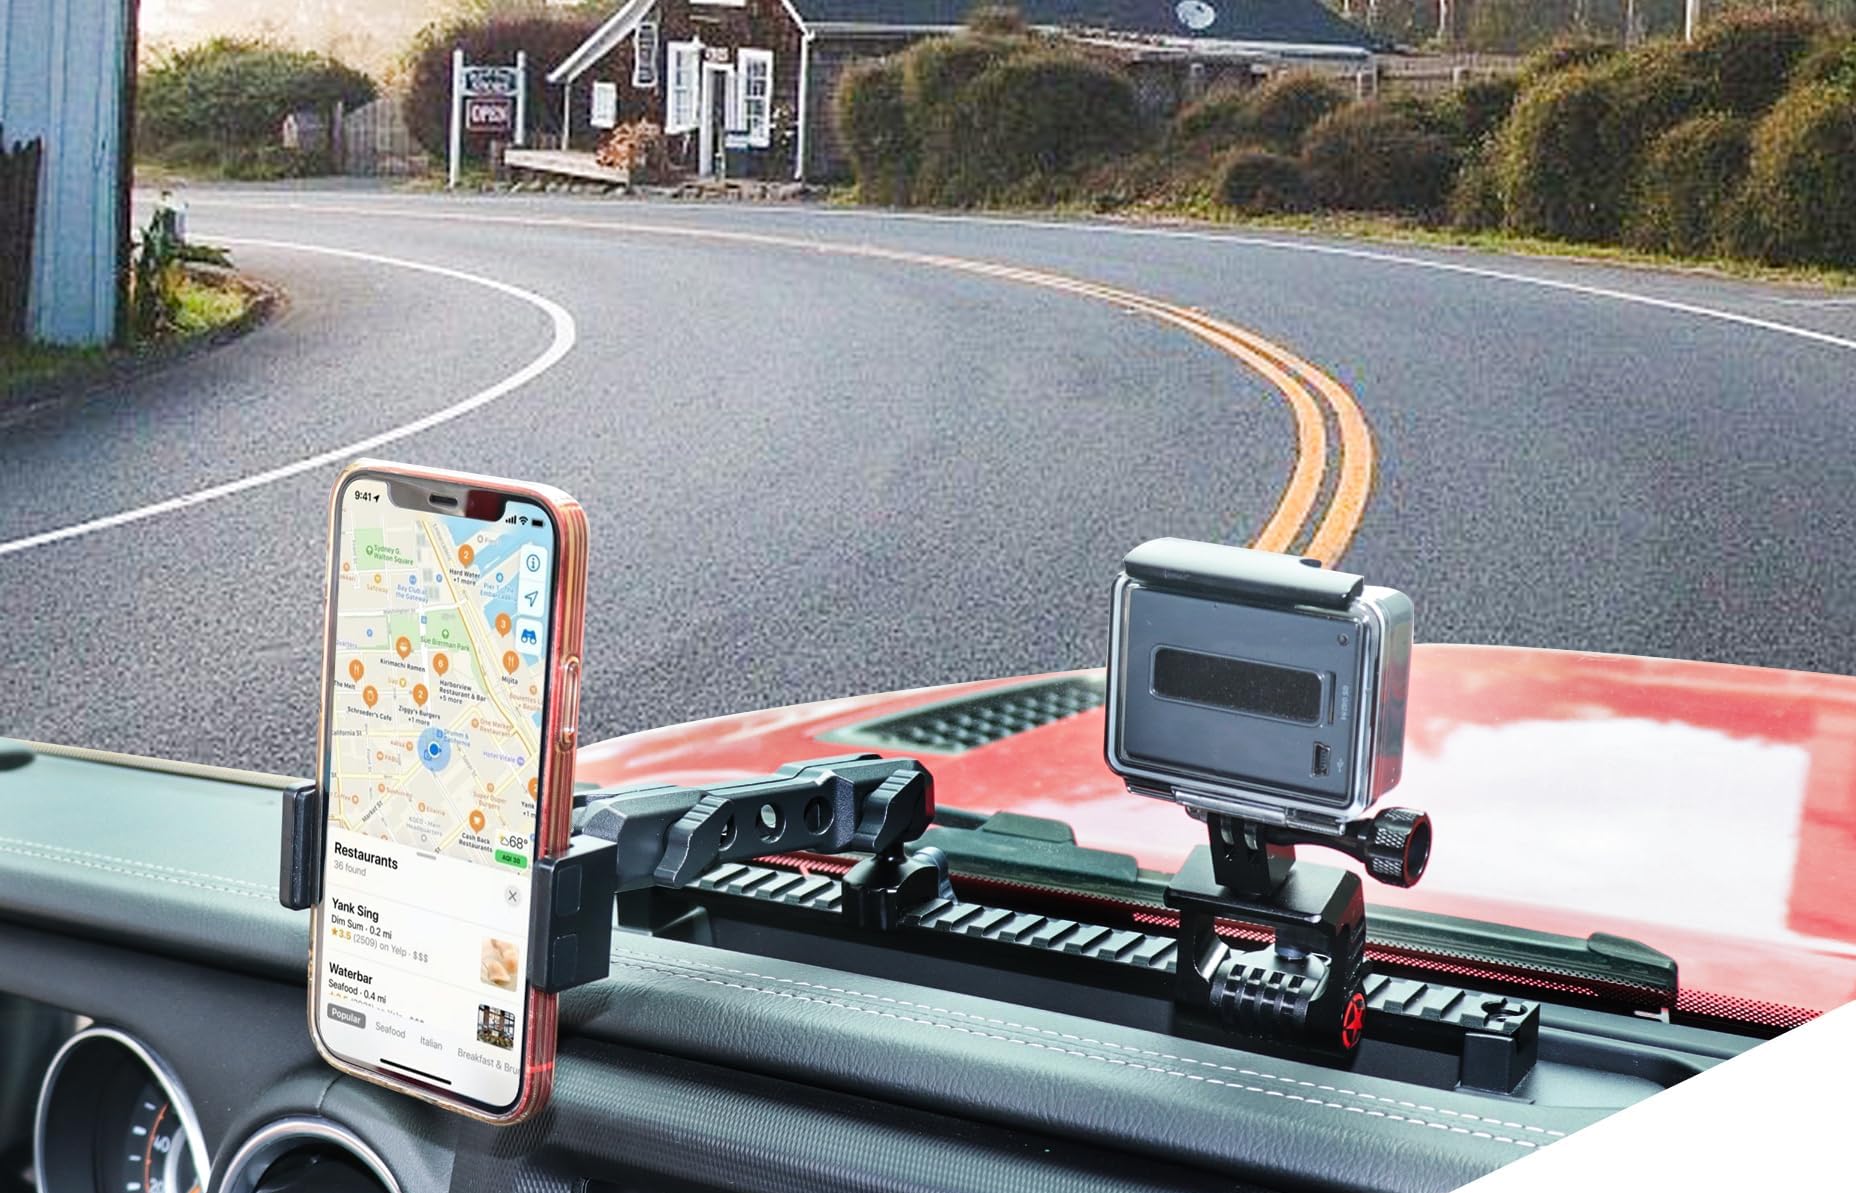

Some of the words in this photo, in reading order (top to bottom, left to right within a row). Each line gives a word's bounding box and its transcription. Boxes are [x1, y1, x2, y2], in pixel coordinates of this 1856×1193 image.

[354, 490, 372, 502] 9:41
[449, 568, 463, 576] Hard
[464, 571, 480, 579] Water
[407, 663, 426, 672] Ramen
[440, 687, 470, 699] Restaurant
[476, 694, 487, 702] Bar
[419, 710, 440, 720] Burgers
[459, 838, 493, 853] Restaurants
[461, 832, 476, 841] Cash
[477, 836, 490, 845] Back
[334, 841, 399, 870] Restaurants
[333, 859, 344, 870] 36
[345, 863, 367, 877] found
[332, 897, 355, 914] Yank
[357, 904, 379, 923] Sing
[331, 914, 346, 926] Dim
[347, 919, 364, 931] Sum
[369, 925, 381, 937] 0.2
[382, 930, 392, 940] mi
[338, 929, 352, 940] 3.5
[353, 934, 378, 949] (2509)
[379, 943, 389, 951] on
[391, 945, 407, 957] Yelp
[413, 950, 429, 963] $$$
[329, 961, 373, 985] Waterbar
[328, 978, 358, 996] Seafood
[363, 989, 376, 1000] 0.4
[377, 995, 387, 1004] mi
[331, 1007, 361, 1025] Popular
[375, 1021, 406, 1039] Seafood
[420, 1035, 443, 1050] Italian
[457, 1047, 494, 1068] Breakfast
[495, 1060, 502, 1070] &
[152, 1136, 171, 1153] 40
